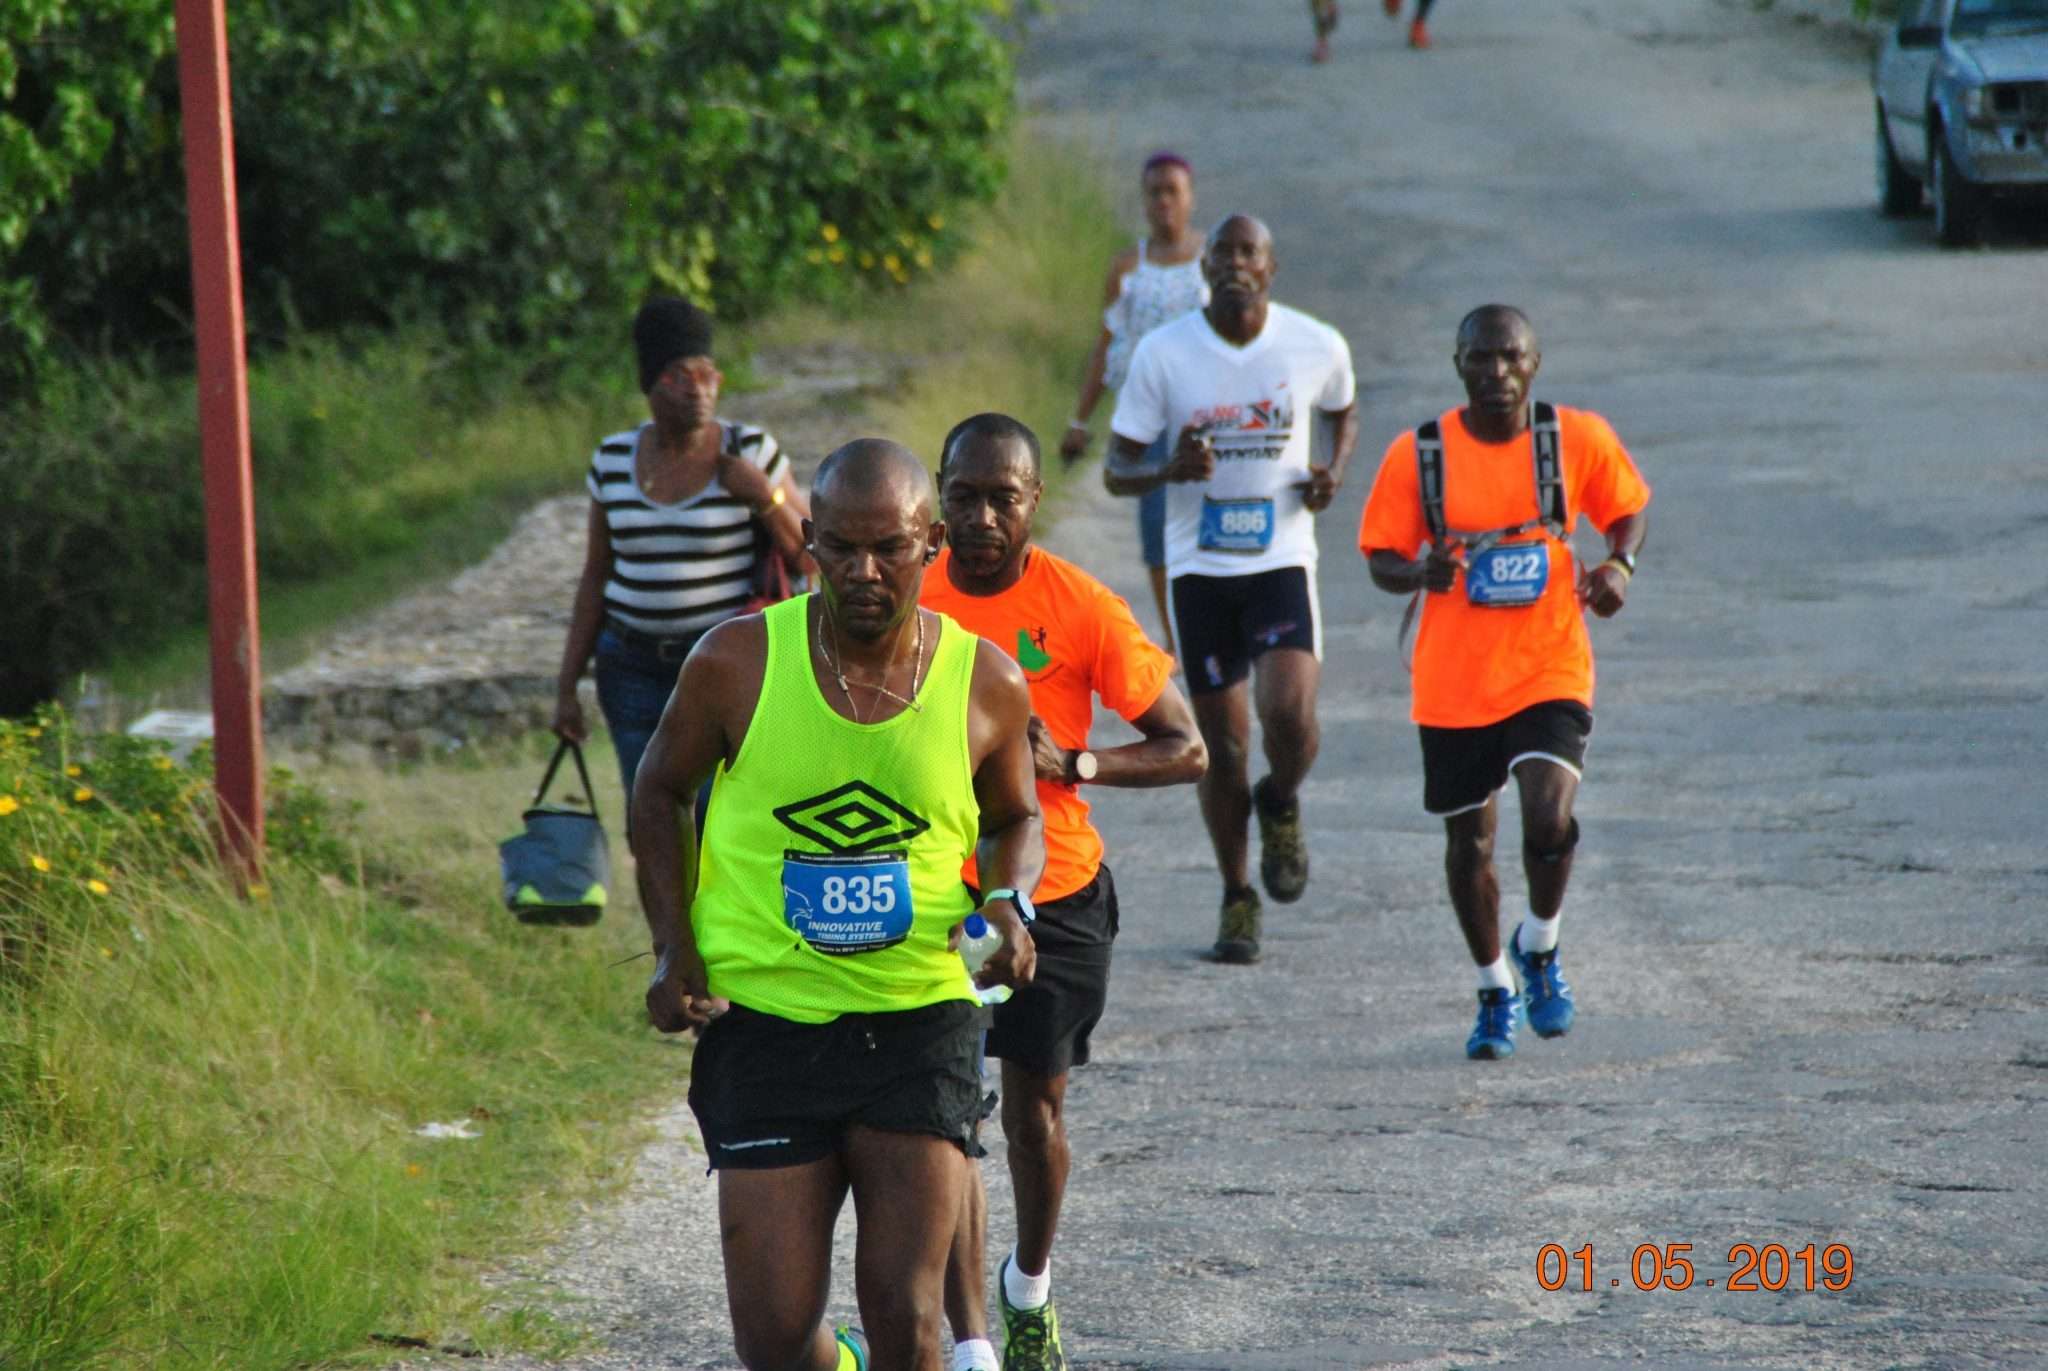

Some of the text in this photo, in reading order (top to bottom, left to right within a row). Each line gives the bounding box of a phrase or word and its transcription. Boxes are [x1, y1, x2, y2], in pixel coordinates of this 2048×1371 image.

[1491, 553, 1541, 582] 822
[822, 874, 896, 914] 835
[807, 921, 884, 932] INNOVATIVE
[817, 932, 846, 940] TIMING
